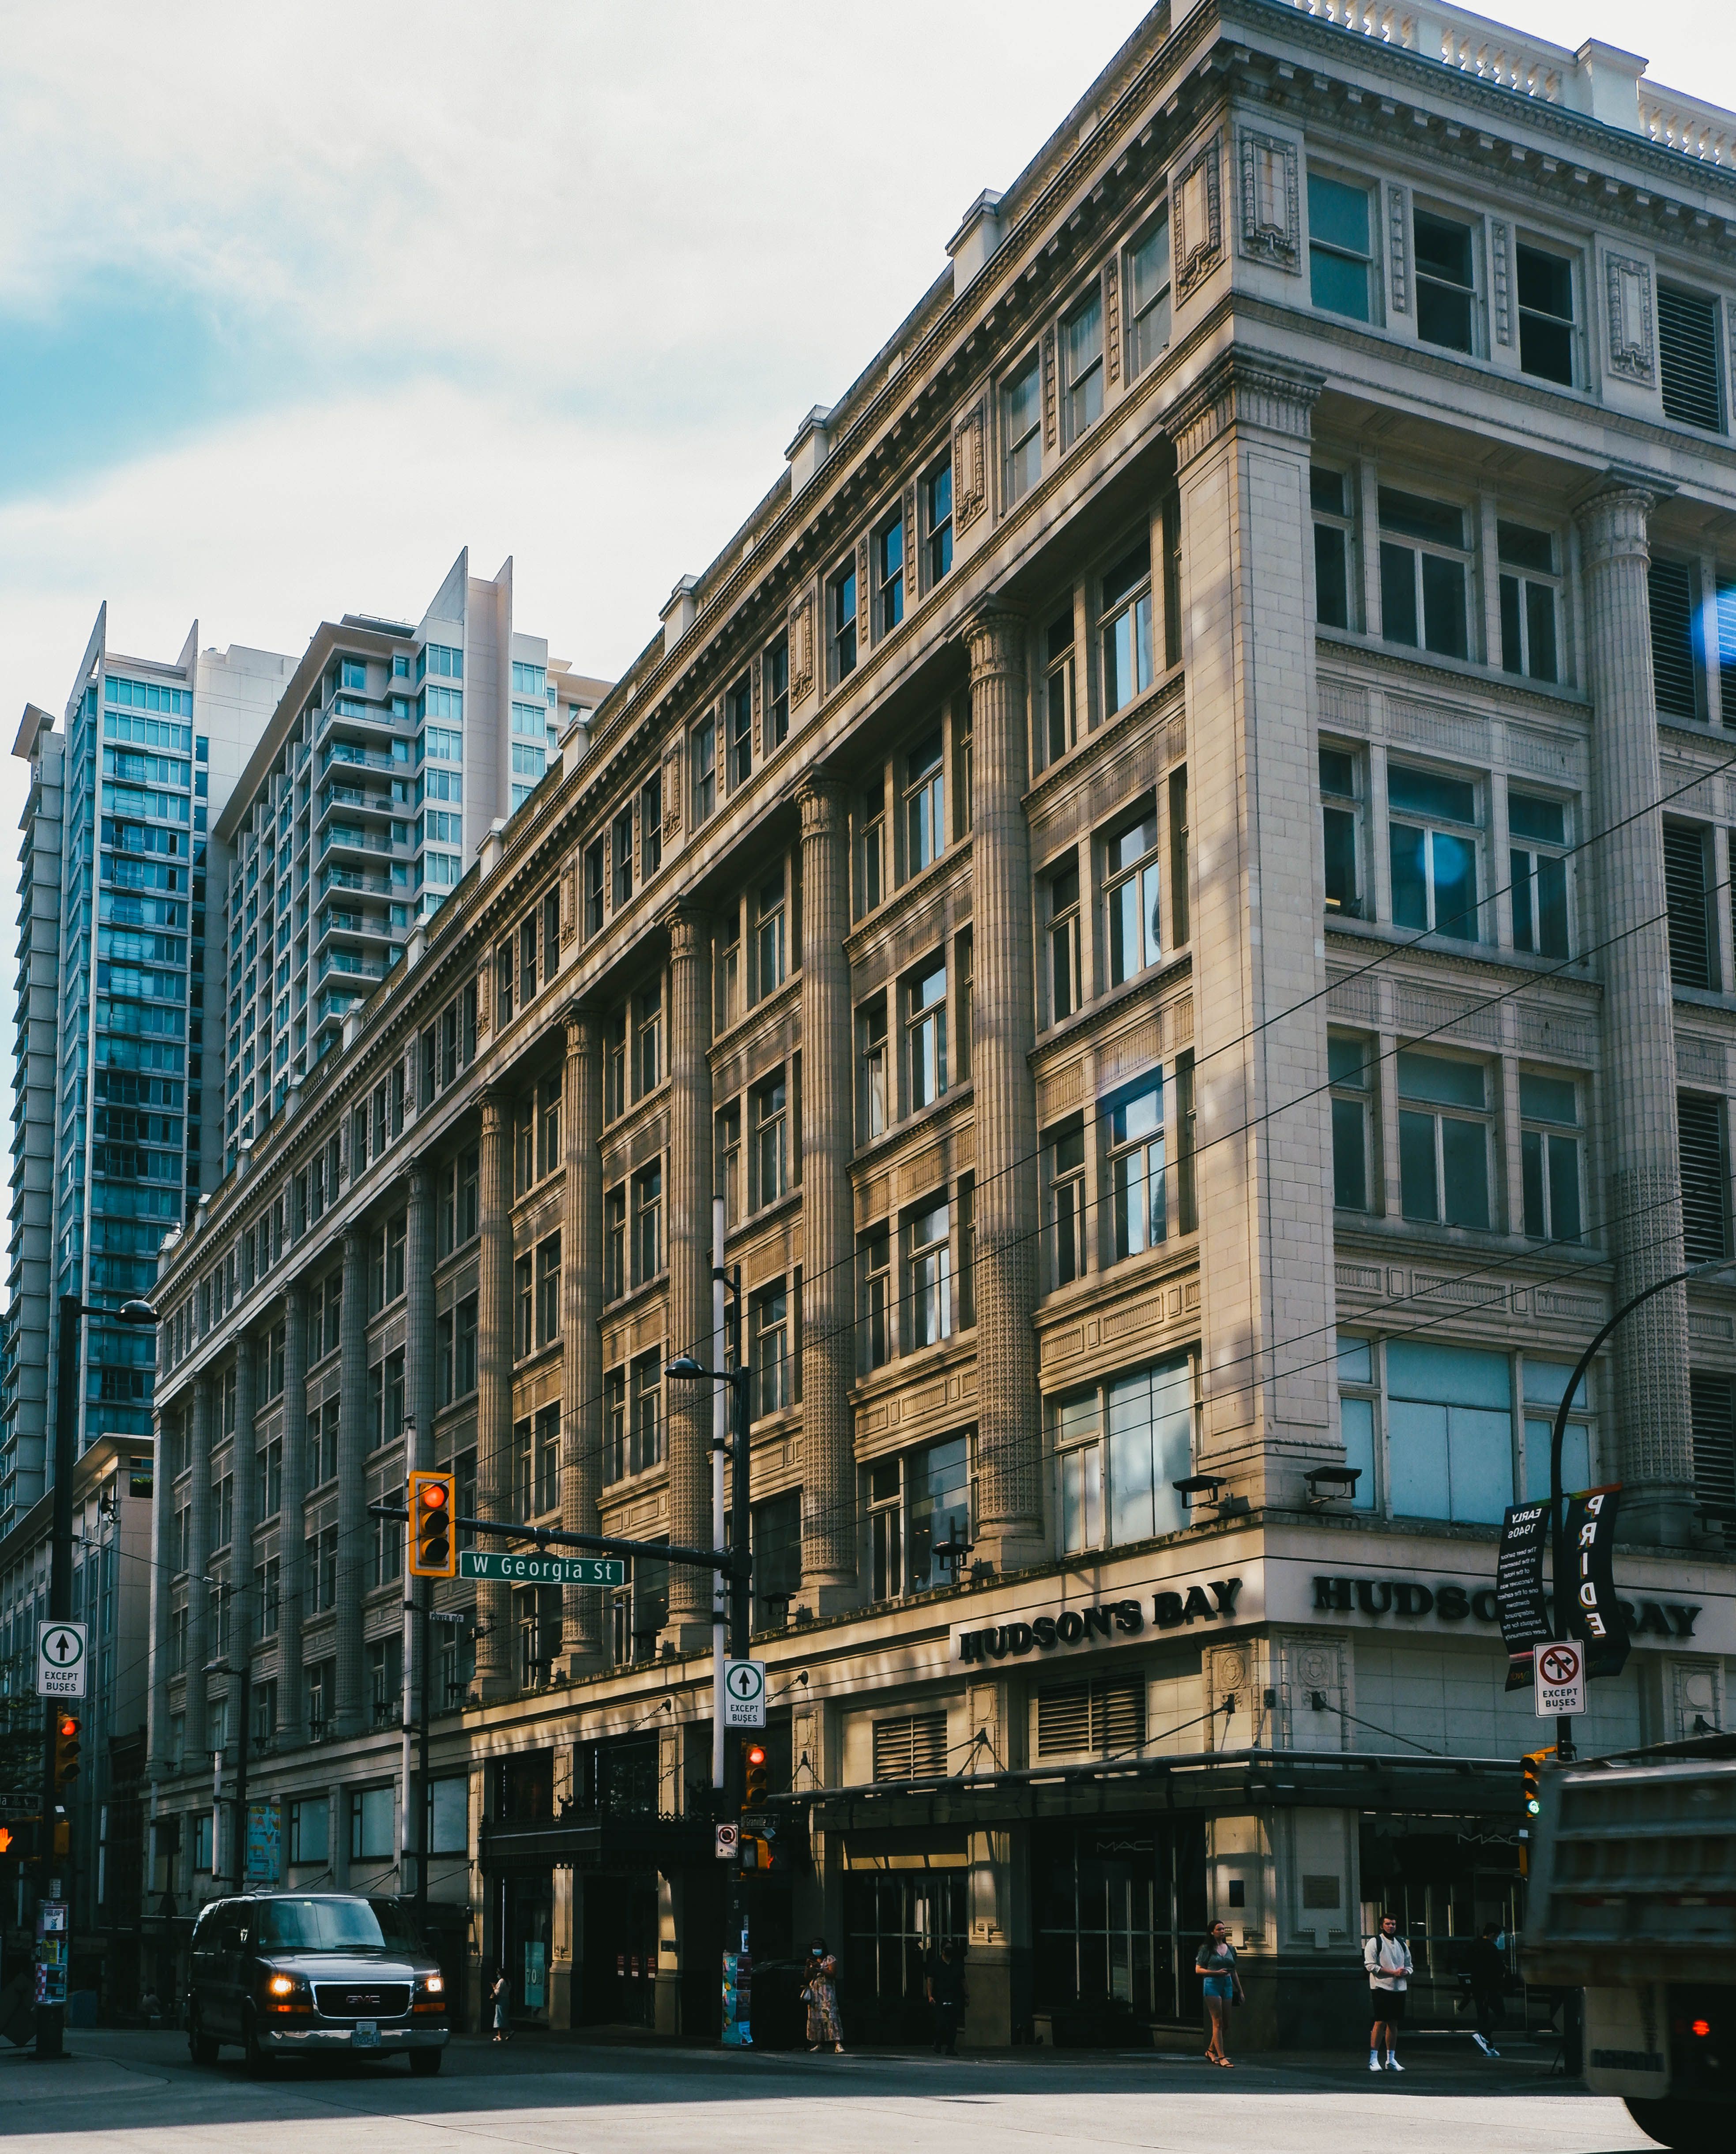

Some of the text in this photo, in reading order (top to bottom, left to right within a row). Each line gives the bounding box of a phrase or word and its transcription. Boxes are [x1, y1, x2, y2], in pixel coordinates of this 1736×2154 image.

[473, 1555, 611, 1581] W Georgia St
[431, 1613, 450, 1622] POWER
[958, 1578, 1242, 1661] HUDSON'S BAY
[45, 1671, 78, 1681] EXCEPT
[46, 1682, 76, 1691] BUSES
[1543, 1688, 1577, 1698] EXCEPT
[1546, 1698, 1575, 1707] BUSES
[346, 1996, 380, 2004] GMC
